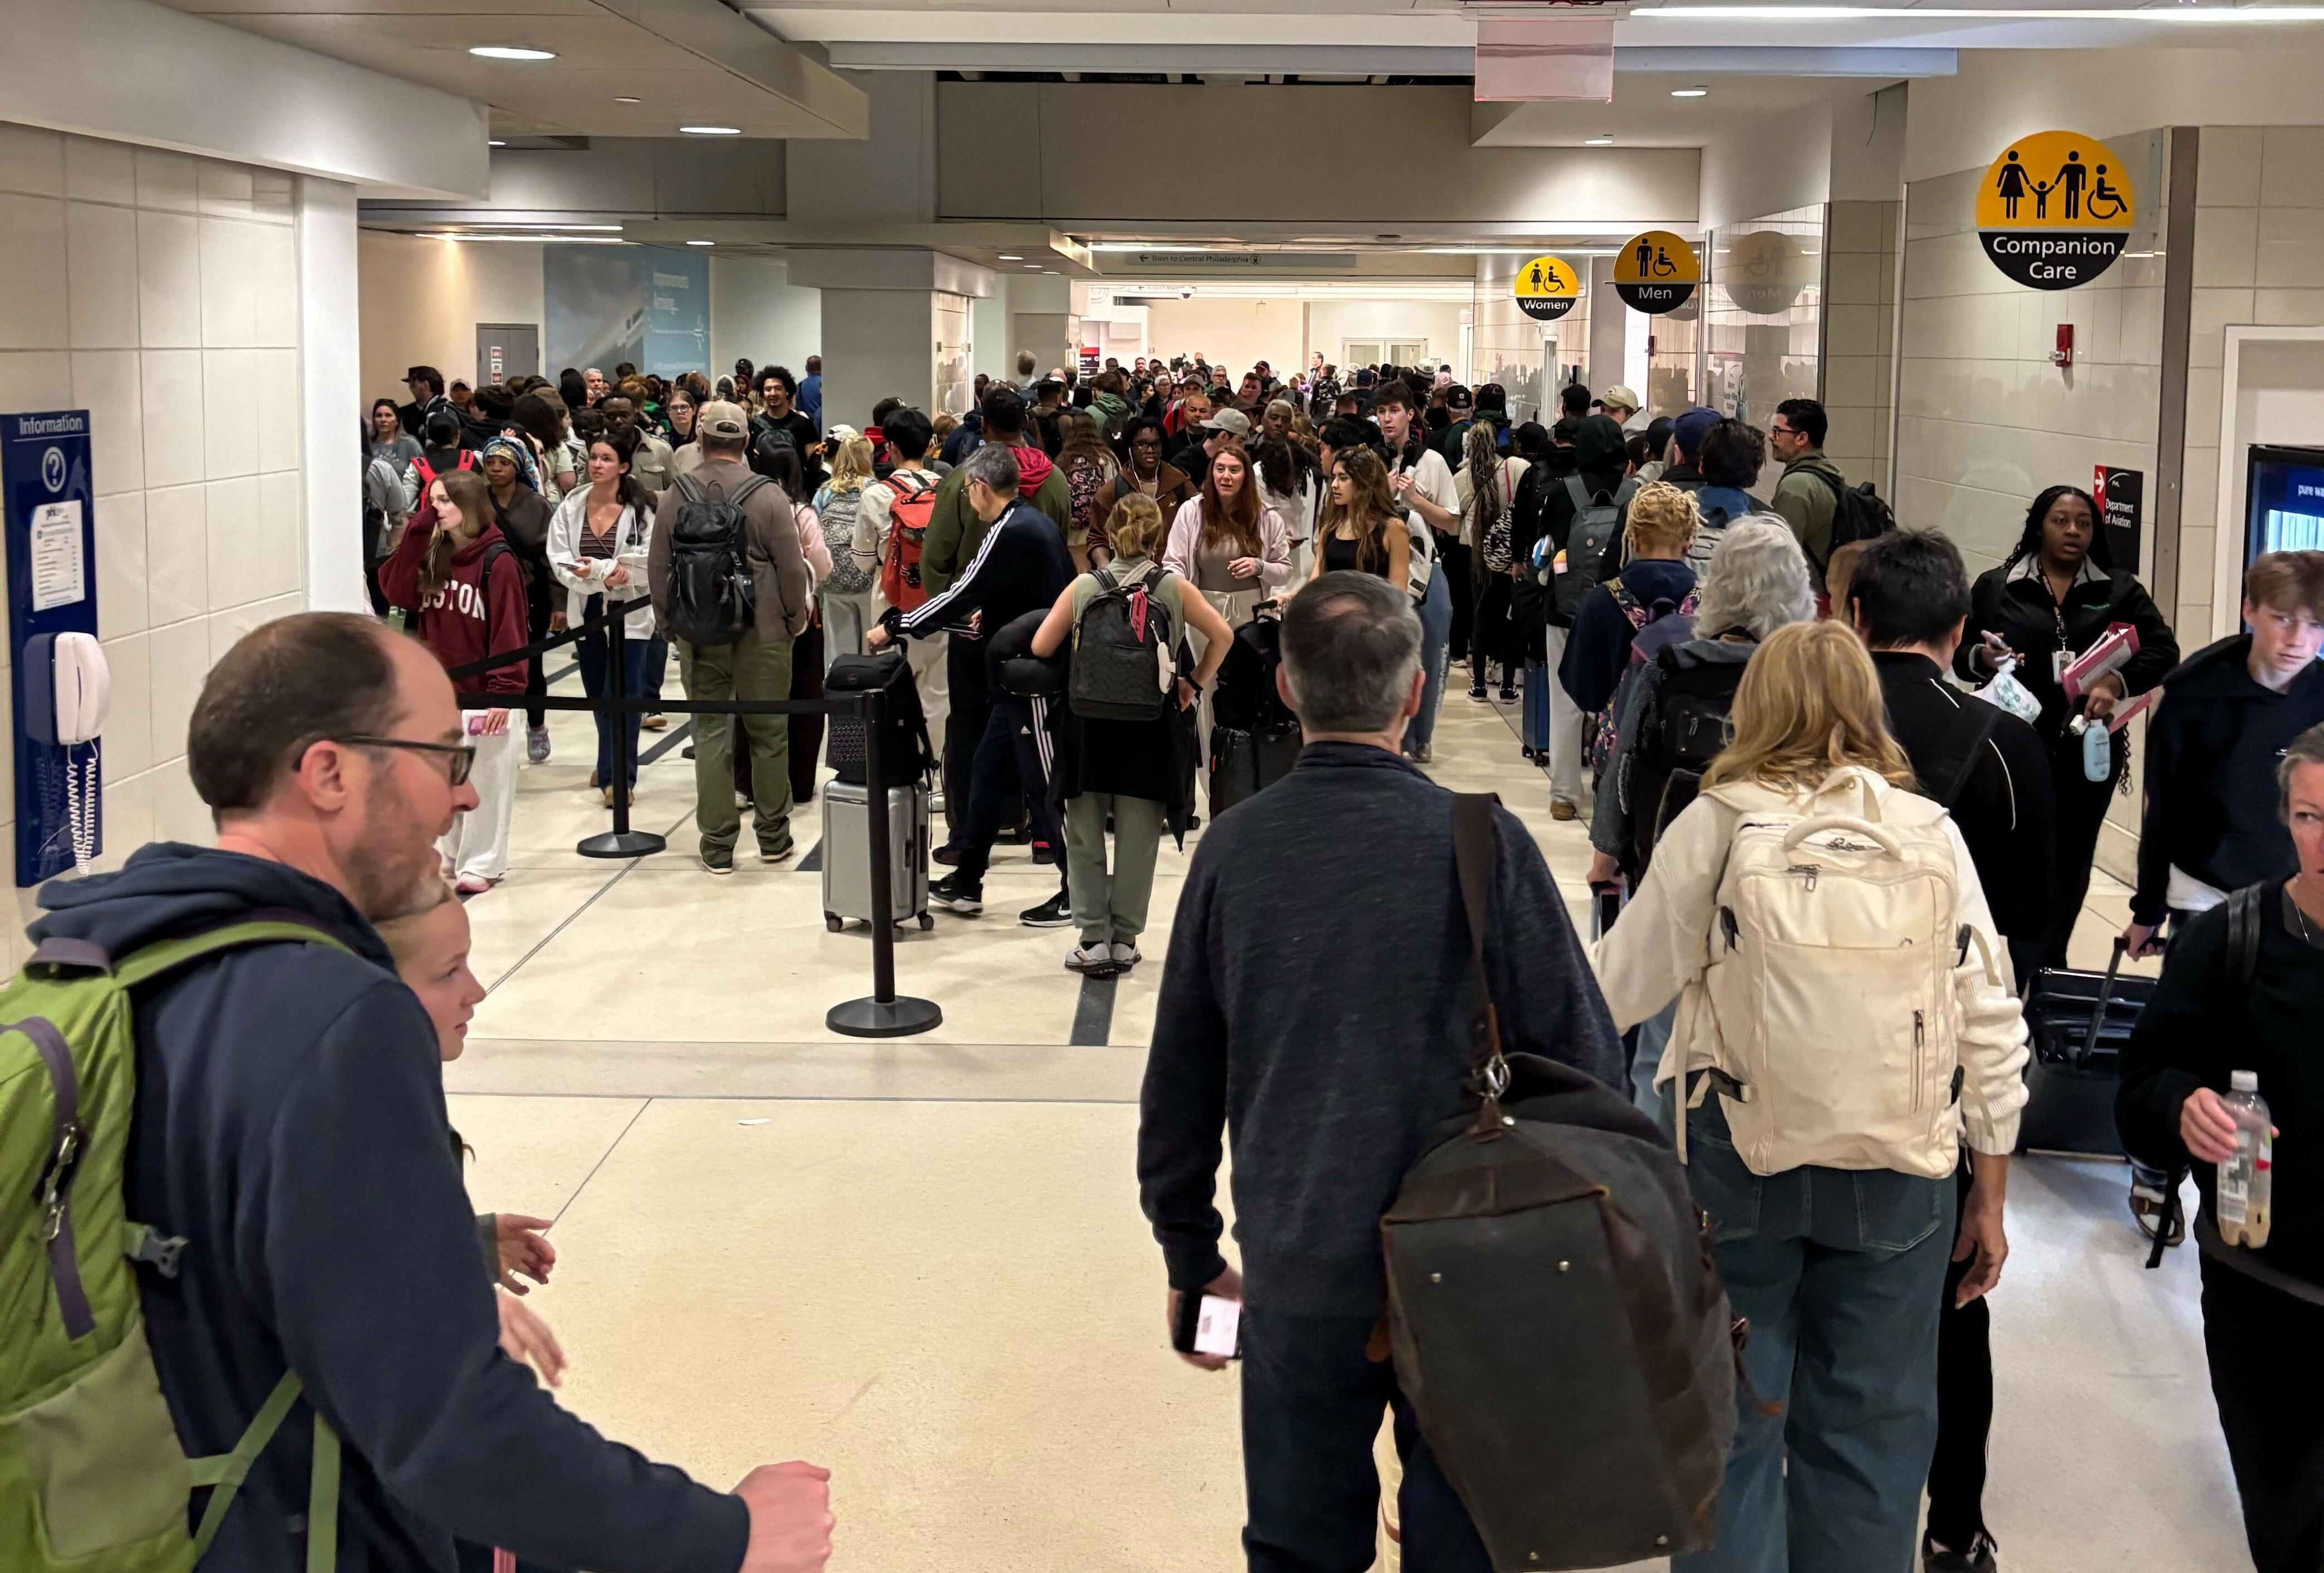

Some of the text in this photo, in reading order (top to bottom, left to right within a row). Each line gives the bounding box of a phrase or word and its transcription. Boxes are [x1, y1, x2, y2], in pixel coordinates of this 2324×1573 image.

[1993, 237, 2115, 258] Companion
[2030, 261, 2077, 279] Care
[1639, 287, 1672, 299] Men
[1524, 299, 1568, 310] Women
[19, 414, 82, 435] Information
[2298, 484, 2314, 497] pure
[2106, 498, 2134, 513] Department
[2105, 513, 2131, 528] of Aviation
